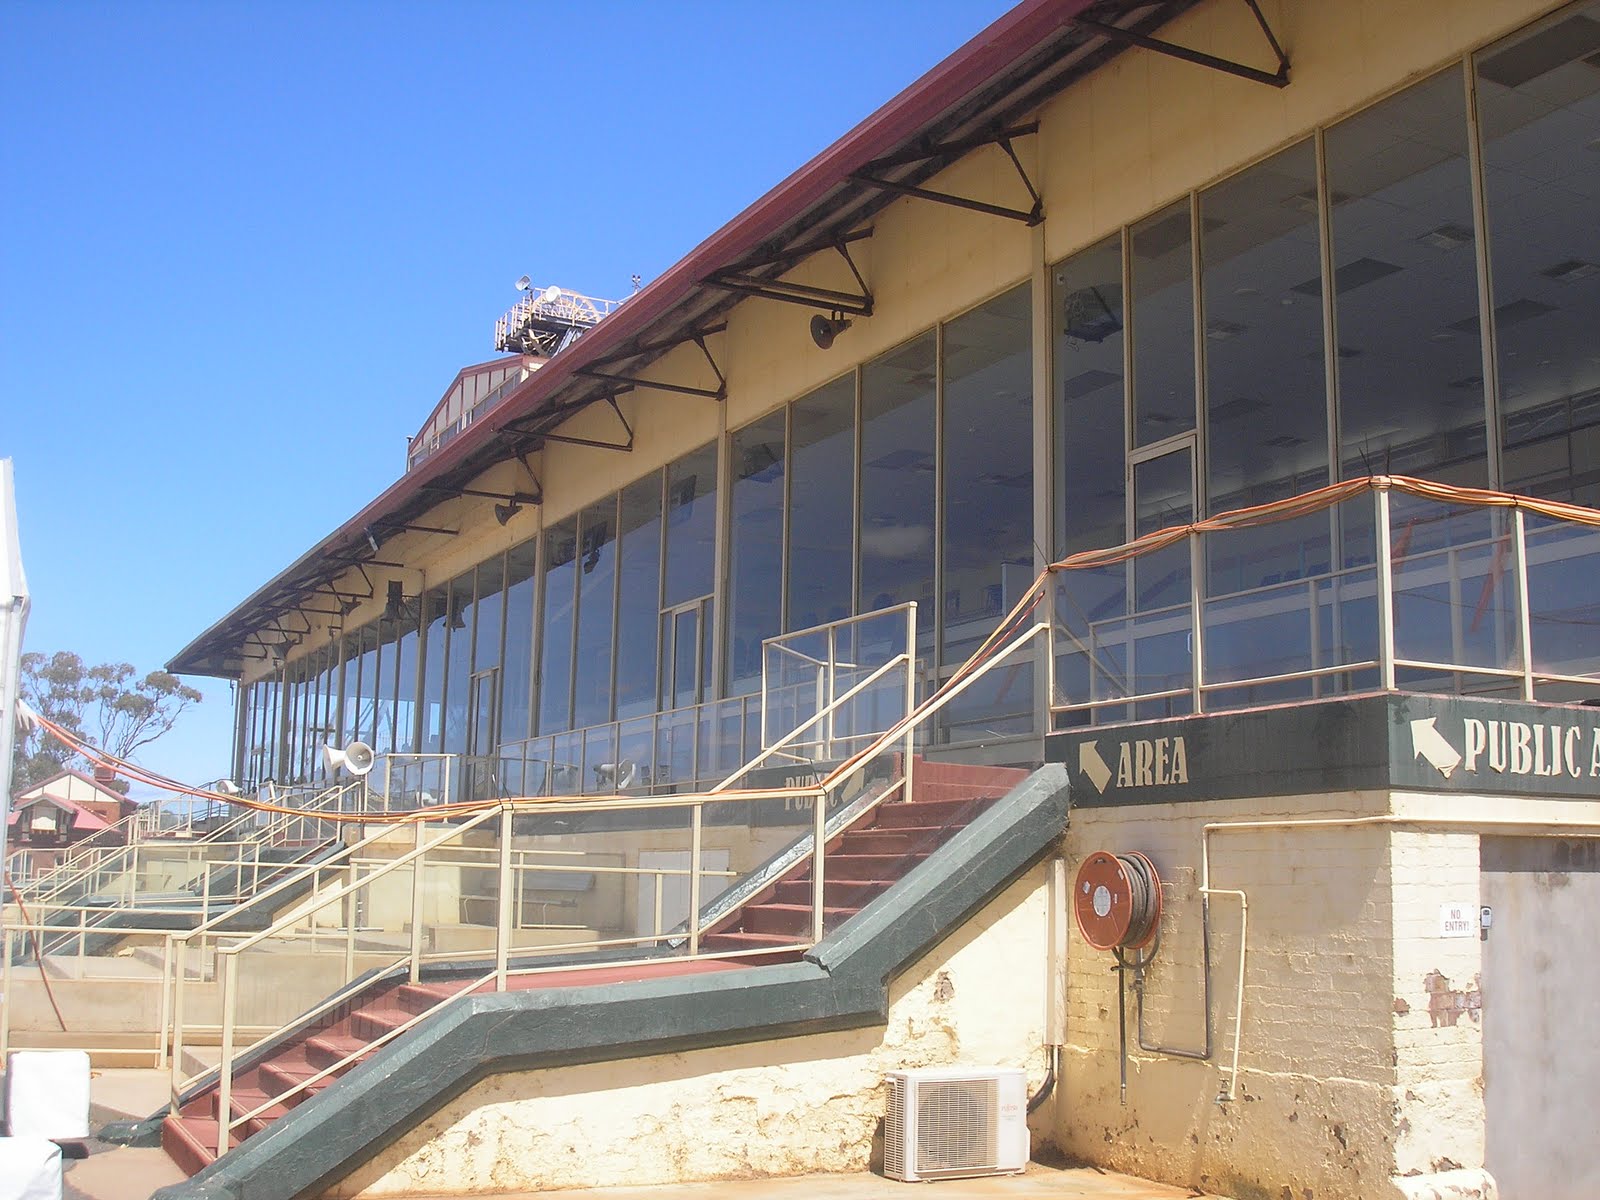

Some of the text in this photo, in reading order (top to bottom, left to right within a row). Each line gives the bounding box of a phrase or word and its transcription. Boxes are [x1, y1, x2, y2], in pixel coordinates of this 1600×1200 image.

[1116, 736, 1189, 788] AREA
[1463, 718, 1581, 778] PUBLIC
[1450, 909, 1461, 920] NO
